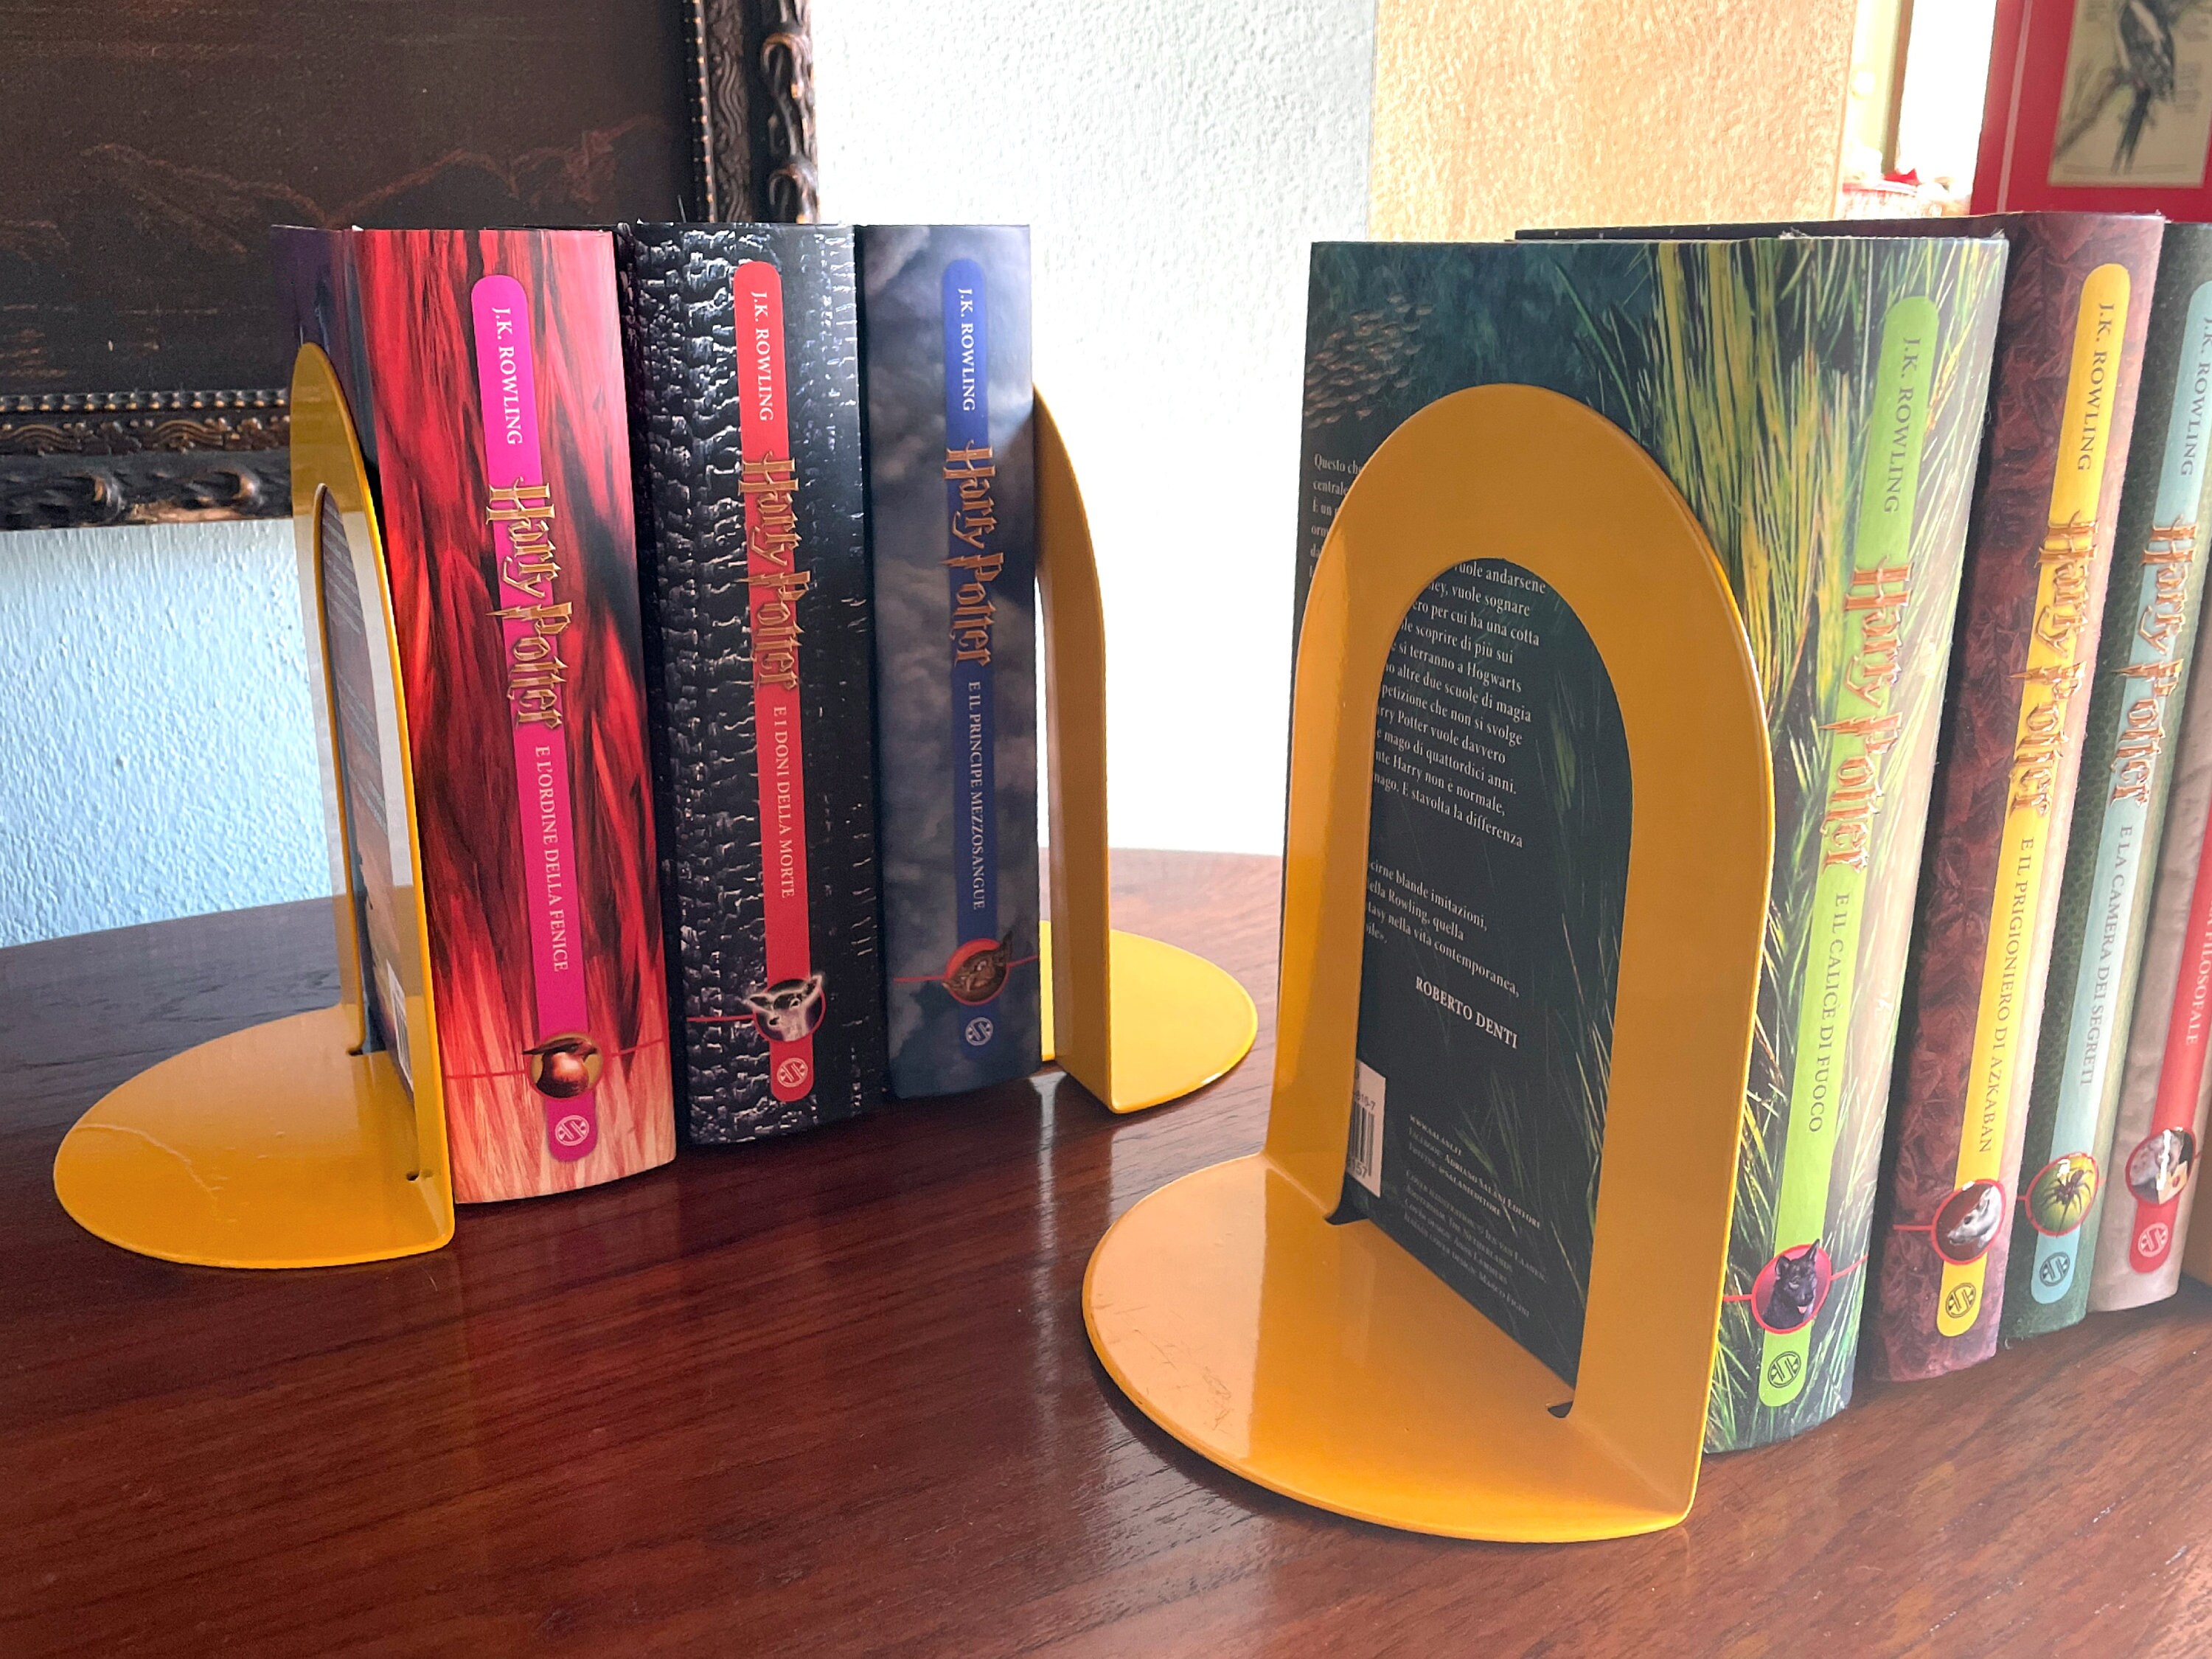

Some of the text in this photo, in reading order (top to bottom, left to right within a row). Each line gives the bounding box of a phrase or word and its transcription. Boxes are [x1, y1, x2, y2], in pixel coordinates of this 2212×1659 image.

[491, 306, 523, 446] J.K. ROWLING
[751, 291, 773, 422] J.K. ROWLING
[959, 288, 975, 411] J.K. ROWLING
[2077, 302, 2115, 471] J.K. ROWLING
[1884, 337, 1921, 514] J.K. ROWLING
[2180, 362, 2211, 476] ROWLING
[1314, 453, 1346, 472] Questo
[733, 451, 810, 690] Harry Potter
[937, 439, 1004, 667] Harry Potter
[1486, 568, 1546, 594] andarsene
[485, 476, 573, 729] Harry Potter
[1430, 605, 1447, 619] per
[1450, 611, 1467, 626] cui
[1470, 612, 1483, 630] ha
[1486, 622, 1507, 637] una
[1510, 627, 1540, 647] cotta
[1452, 586, 1481, 603] vuole
[1484, 594, 1531, 616] sognare
[1399, 641, 1408, 655] si
[1410, 646, 1455, 670] terranno
[1457, 663, 1464, 674] a
[1467, 662, 1522, 693] Hogwarts
[1415, 625, 1458, 647] scoprire
[1461, 635, 1472, 651] di
[1474, 641, 1493, 658] più
[1496, 650, 1514, 664] sui
[2007, 509, 2099, 818] Harry Potter
[2110, 515, 2199, 806] Harry Potter
[773, 706, 787, 717] E
[1397, 664, 1420, 683] altre
[1423, 672, 1442, 690] due
[1444, 684, 1478, 703] scuole
[1481, 692, 1492, 709] di
[1496, 701, 1531, 723] magia
[1430, 700, 1448, 717] che
[1450, 709, 1471, 726] non
[1475, 717, 1484, 731] si
[1486, 724, 1523, 747] svolge
[1818, 554, 1913, 875] Harry Potter
[774, 731, 790, 777] DONI
[1385, 730, 1411, 752] mago
[1413, 739, 1424, 756] di
[1426, 748, 1484, 782] quattordici
[1488, 774, 1517, 795] anni.
[1398, 710, 1429, 733] Potter
[1430, 727, 1459, 745] vuole
[1462, 736, 1506, 764] davvero
[777, 782, 792, 836] DELLA
[969, 681, 986, 911] E IL PRINCIPE MEZZOSANGUE
[1394, 755, 1422, 782] Harry
[1425, 771, 1444, 788] non
[1456, 784, 1506, 816] normale,
[1411, 787, 1450, 815] stavolta
[1454, 804, 1463, 821] la
[1466, 810, 1523, 848] differenza
[535, 745, 568, 973] E L'ORDINE DELLA FENICE
[780, 840, 795, 898] MORTE
[1369, 880, 1464, 942] ella Rowling, quella
[1396, 869, 1429, 898] blande
[1430, 888, 1487, 931] imitazioni,
[1388, 914, 1411, 936] nella
[1413, 928, 1432, 946] vita
[1434, 941, 1520, 998] contemporanea,
[2081, 826, 2133, 1085] E LA CAMERA DEI SEGRETI
[1416, 975, 1518, 1049] ROBERTO DENTI
[1809, 892, 1849, 1133] E IL CALICE DI FUOCO
[1979, 837, 2034, 1152] E IL PRIGIONIERO DI AZKABAN
